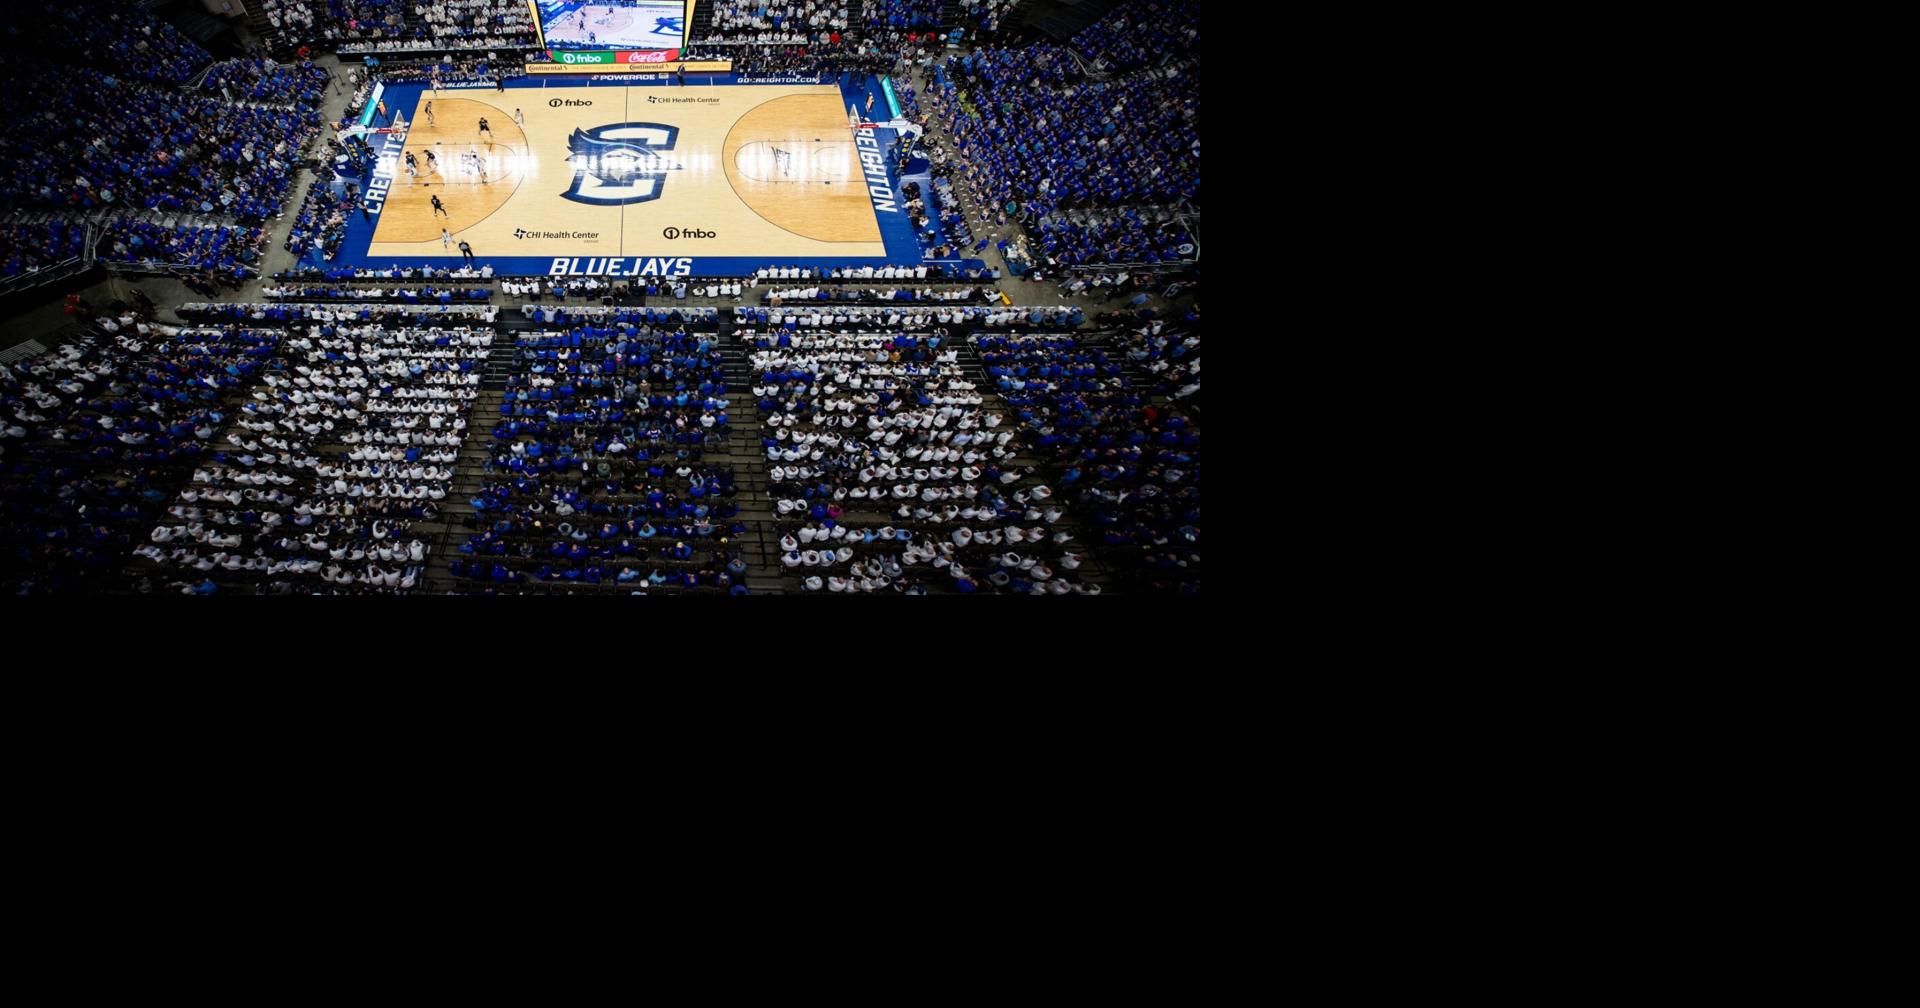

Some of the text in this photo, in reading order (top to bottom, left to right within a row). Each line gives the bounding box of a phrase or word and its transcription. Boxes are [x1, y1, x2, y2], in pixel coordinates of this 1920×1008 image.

[576, 54, 602, 63] fnbo
[565, 99, 593, 107] fnbo
[526, 230, 599, 239] CHI Health Center
[682, 227, 717, 240] fnbo
[549, 257, 693, 277] BLUEJAYS
